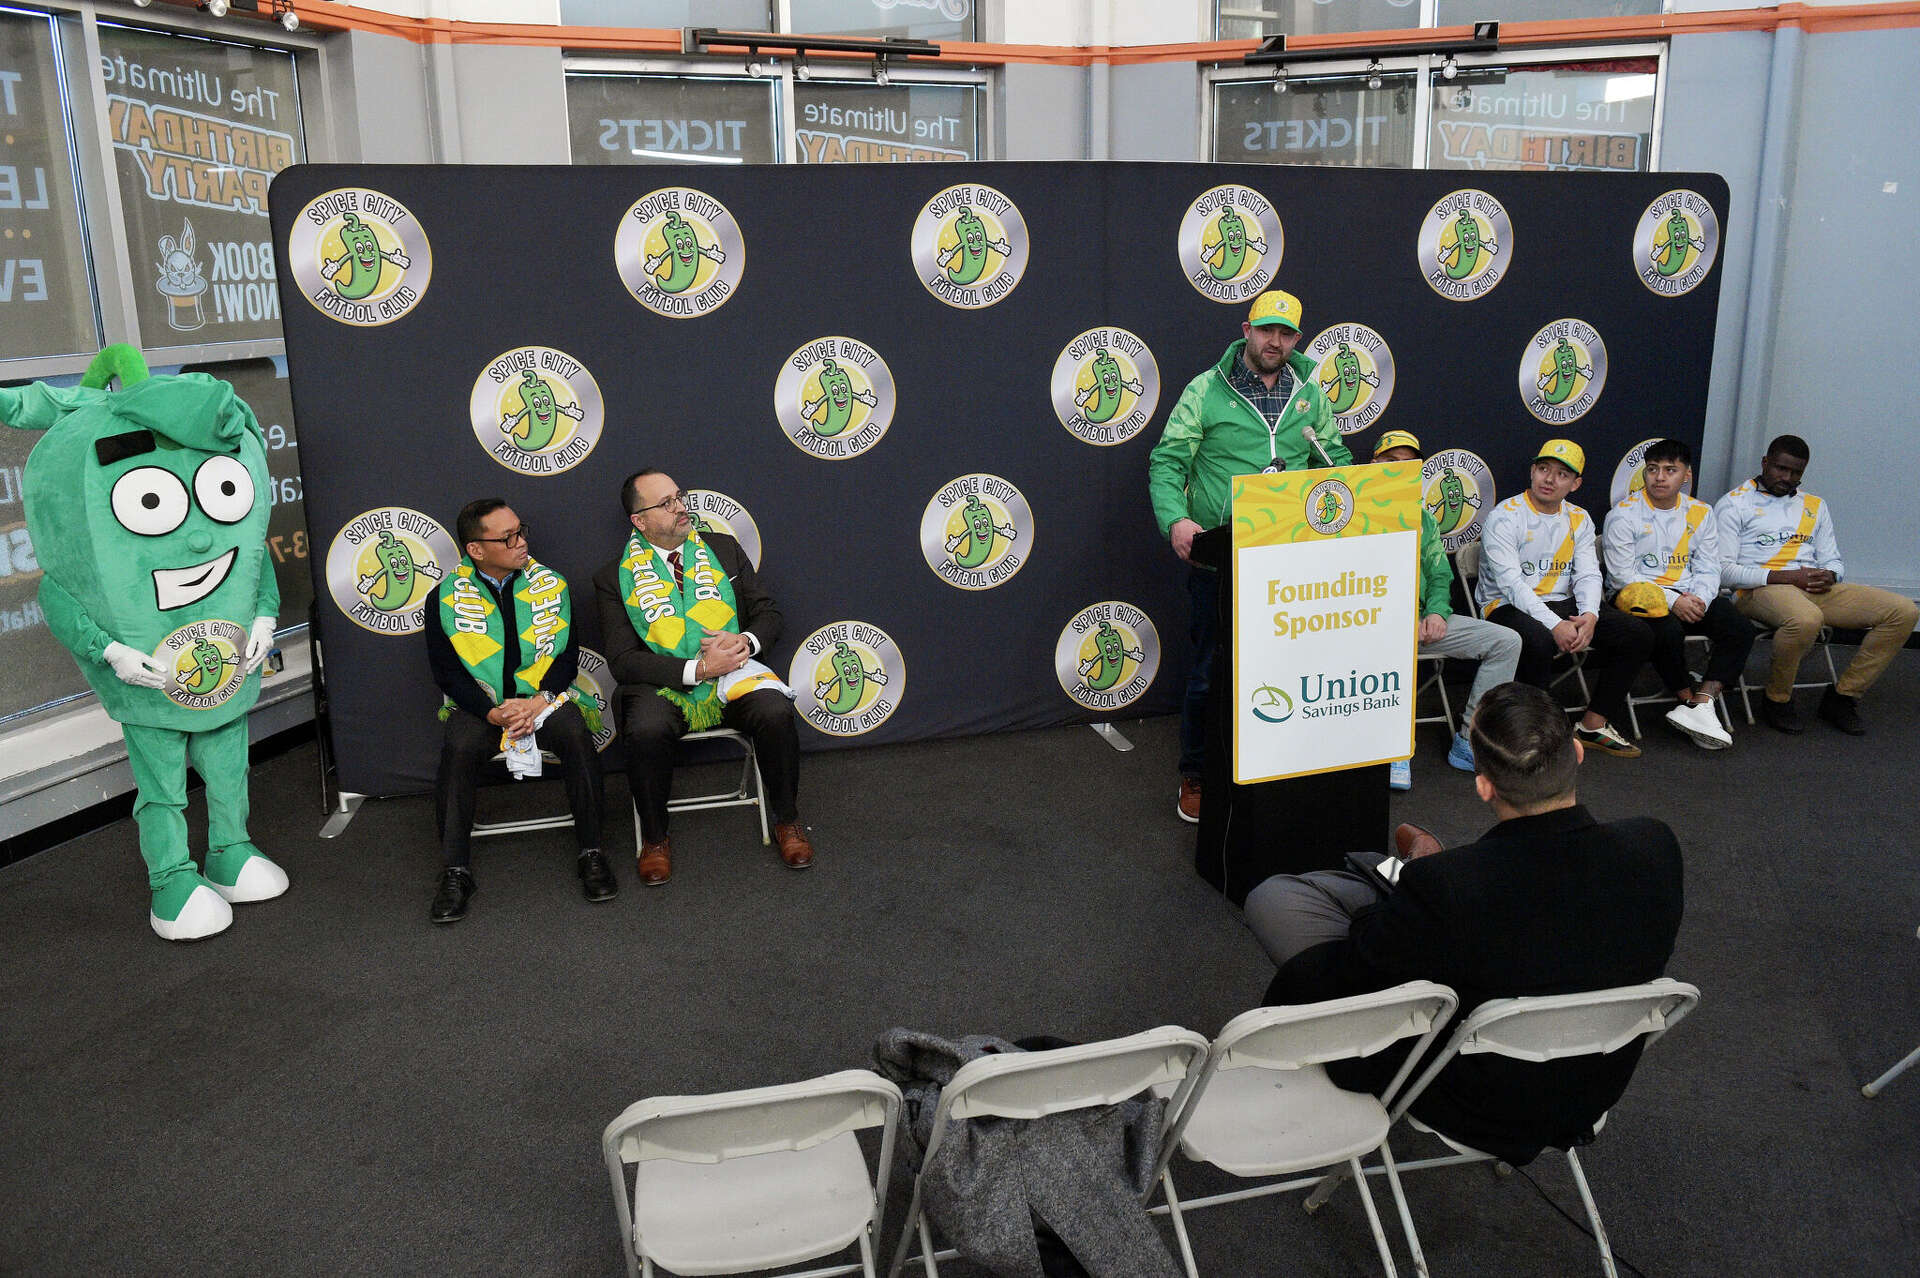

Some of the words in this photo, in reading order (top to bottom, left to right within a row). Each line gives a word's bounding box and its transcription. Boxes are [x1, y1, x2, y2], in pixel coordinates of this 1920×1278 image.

[307, 192, 358, 225] SPICE
[364, 194, 406, 225] CITY
[633, 191, 680, 224] SPICE
[685, 193, 723, 221] CITY
[929, 188, 971, 219] SPICE
[976, 189, 1011, 216] CITY
[1195, 188, 1235, 216] SPICE
[1239, 189, 1269, 216] CITY
[1435, 193, 1471, 219] SPICE
[1475, 194, 1502, 219] CITY
[1651, 193, 1683, 219] SPICE
[1686, 194, 1709, 218] CITY
[982, 272, 1015, 302] CLUB
[1241, 270, 1269, 297] CLUB
[1471, 269, 1499, 295] CLUB
[1680, 266, 1705, 291] CLUB
[381, 286, 417, 320] CLUB
[696, 280, 730, 311] CLUB
[1068, 331, 1108, 360] SPICE
[1112, 332, 1144, 358] CITY
[1314, 326, 1350, 354] SPICE
[1354, 328, 1383, 352] CITY
[1536, 322, 1569, 348] SPICE
[1571, 322, 1598, 347] CITY
[488, 350, 537, 383] SPICE
[541, 351, 580, 380] CITY
[792, 340, 835, 372] SPICE
[840, 341, 877, 369] CITY
[1354, 402, 1381, 429] CLUB
[1568, 394, 1594, 420] CLUB
[848, 423, 881, 453] CLUB
[1117, 410, 1147, 439] CLUB
[554, 437, 590, 469] CLUB
[1421, 452, 1455, 480] SPICE
[1458, 453, 1483, 476] CITY
[1627, 441, 1657, 467] SPI
[703, 493, 741, 521] CITY
[938, 478, 979, 508] SPICE
[983, 478, 1017, 504] CITY
[344, 512, 393, 545] SPICE
[397, 512, 440, 541] CITY
[1458, 522, 1481, 547] CLUB
[694, 549, 722, 601] CLUB
[989, 555, 1020, 583] CLUB
[632, 558, 676, 624] SPICE
[1267, 571, 1389, 605] Founding
[453, 577, 488, 635] CLUB
[1072, 605, 1110, 633] SPICE
[1114, 605, 1145, 629] CITY
[166, 622, 207, 650] SPICE
[210, 622, 240, 639] CITY
[531, 592, 562, 664] SPICE
[1273, 606, 1382, 640] Sponsor
[805, 624, 847, 655] SPICE
[852, 625, 887, 651] CITY
[577, 651, 604, 673] ITY
[219, 675, 242, 702] CLUB
[1117, 677, 1148, 704] CLUB
[1300, 669, 1401, 703] Union
[860, 701, 892, 727] CLUB
[1302, 699, 1360, 720] Savings
[1362, 694, 1400, 712] Bank
[591, 729, 611, 746] UB
